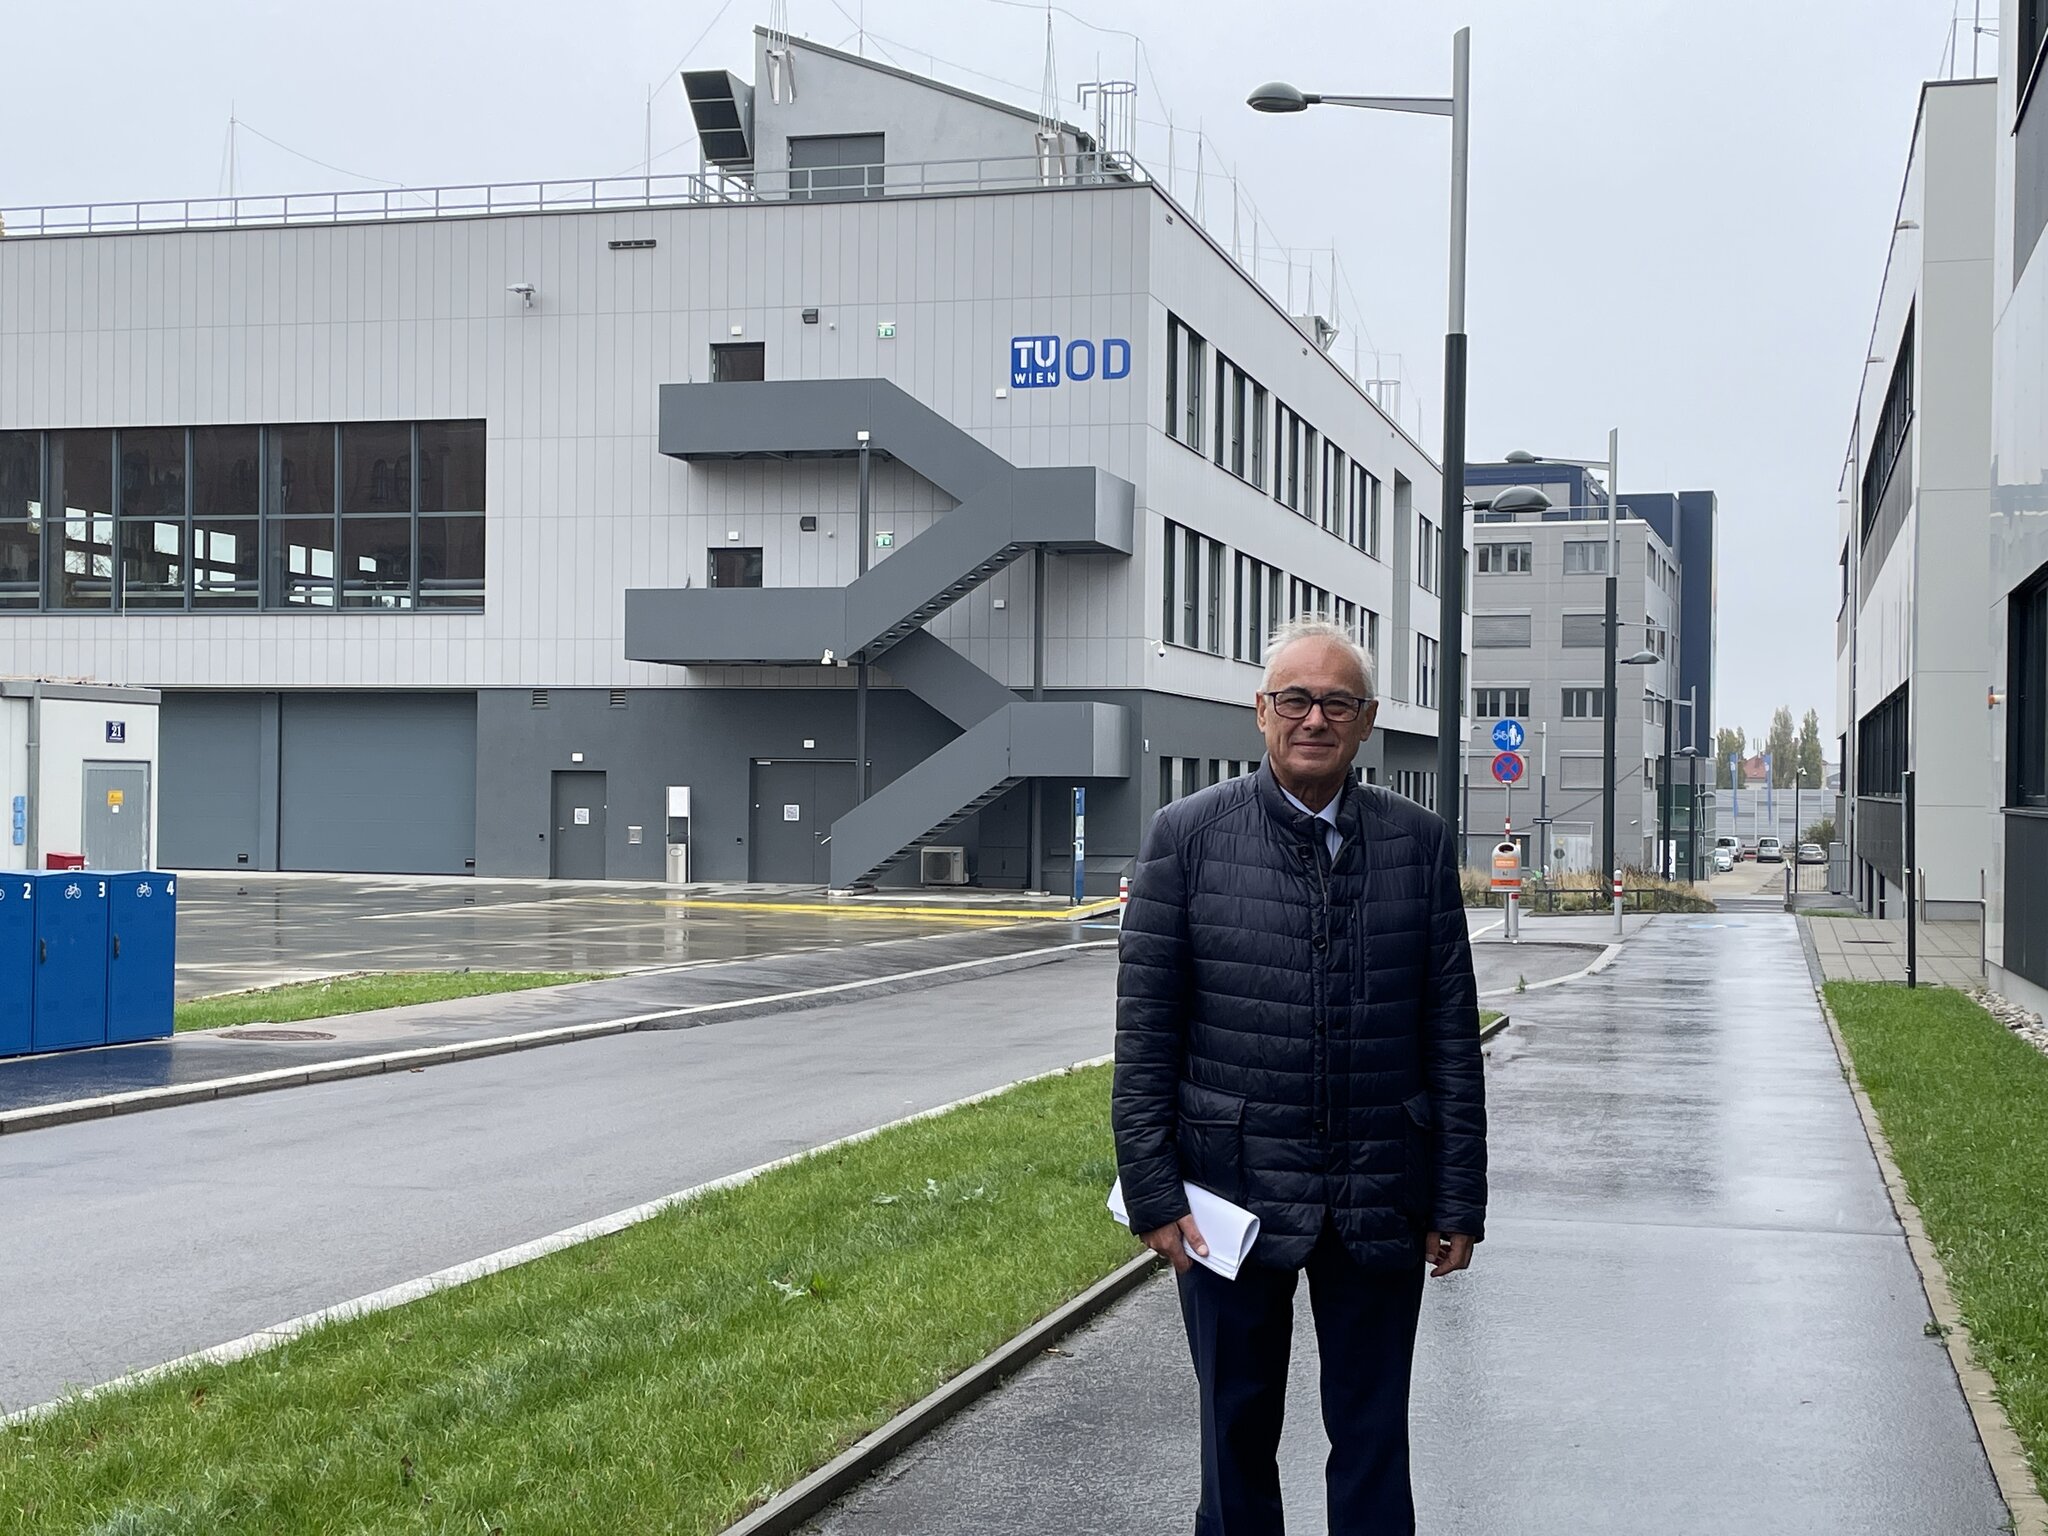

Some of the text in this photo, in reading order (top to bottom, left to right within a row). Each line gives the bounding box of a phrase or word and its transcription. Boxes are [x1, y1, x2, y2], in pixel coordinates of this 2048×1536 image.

[1014, 340, 1056, 368] TU
[1066, 339, 1131, 381] OD
[1014, 372, 1056, 384] WIEN
[111, 725, 121, 736] 21
[23, 883, 31, 899] 2
[98, 882, 106, 898] 3
[166, 881, 174, 895] 4
